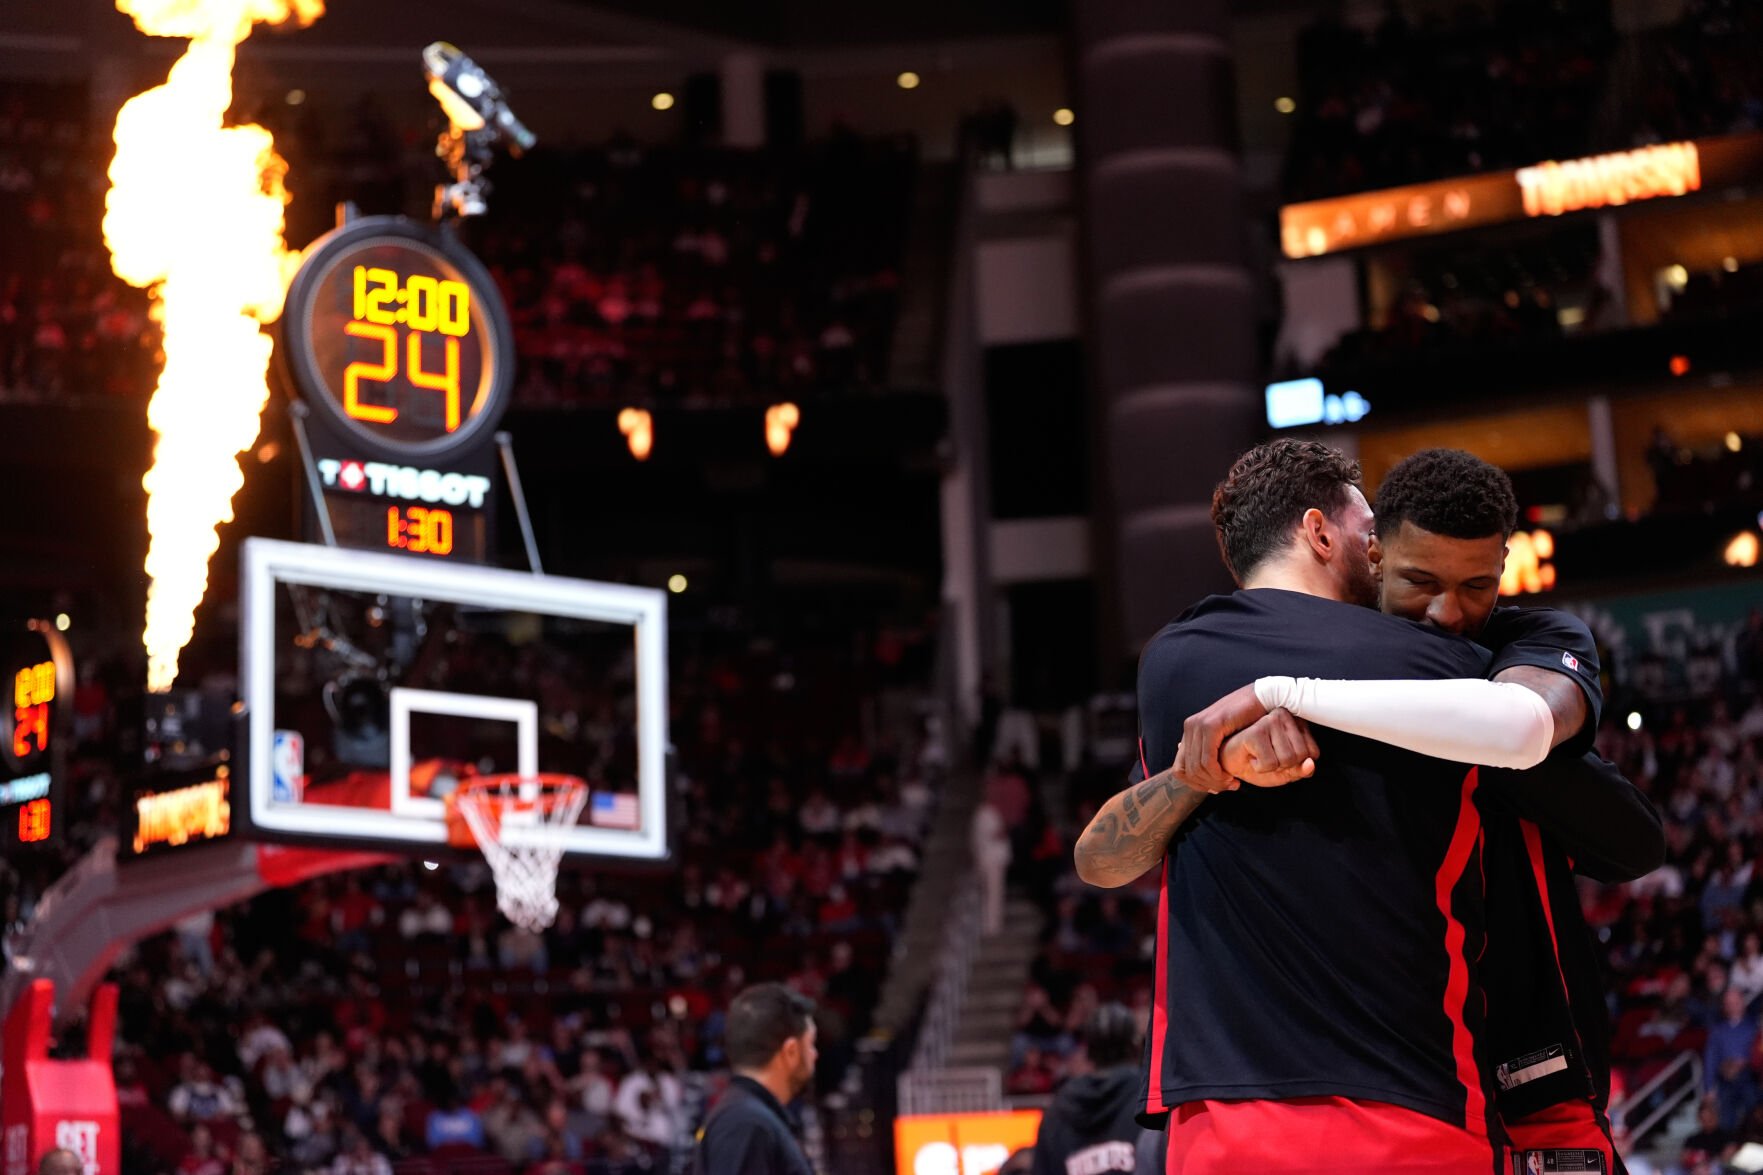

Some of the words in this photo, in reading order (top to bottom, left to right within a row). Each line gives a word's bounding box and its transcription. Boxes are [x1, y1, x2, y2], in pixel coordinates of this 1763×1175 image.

[354, 265, 470, 338] 12:00
[344, 319, 460, 433] 24
[364, 461, 491, 508] TISSOT
[387, 505, 453, 556] 1:30
